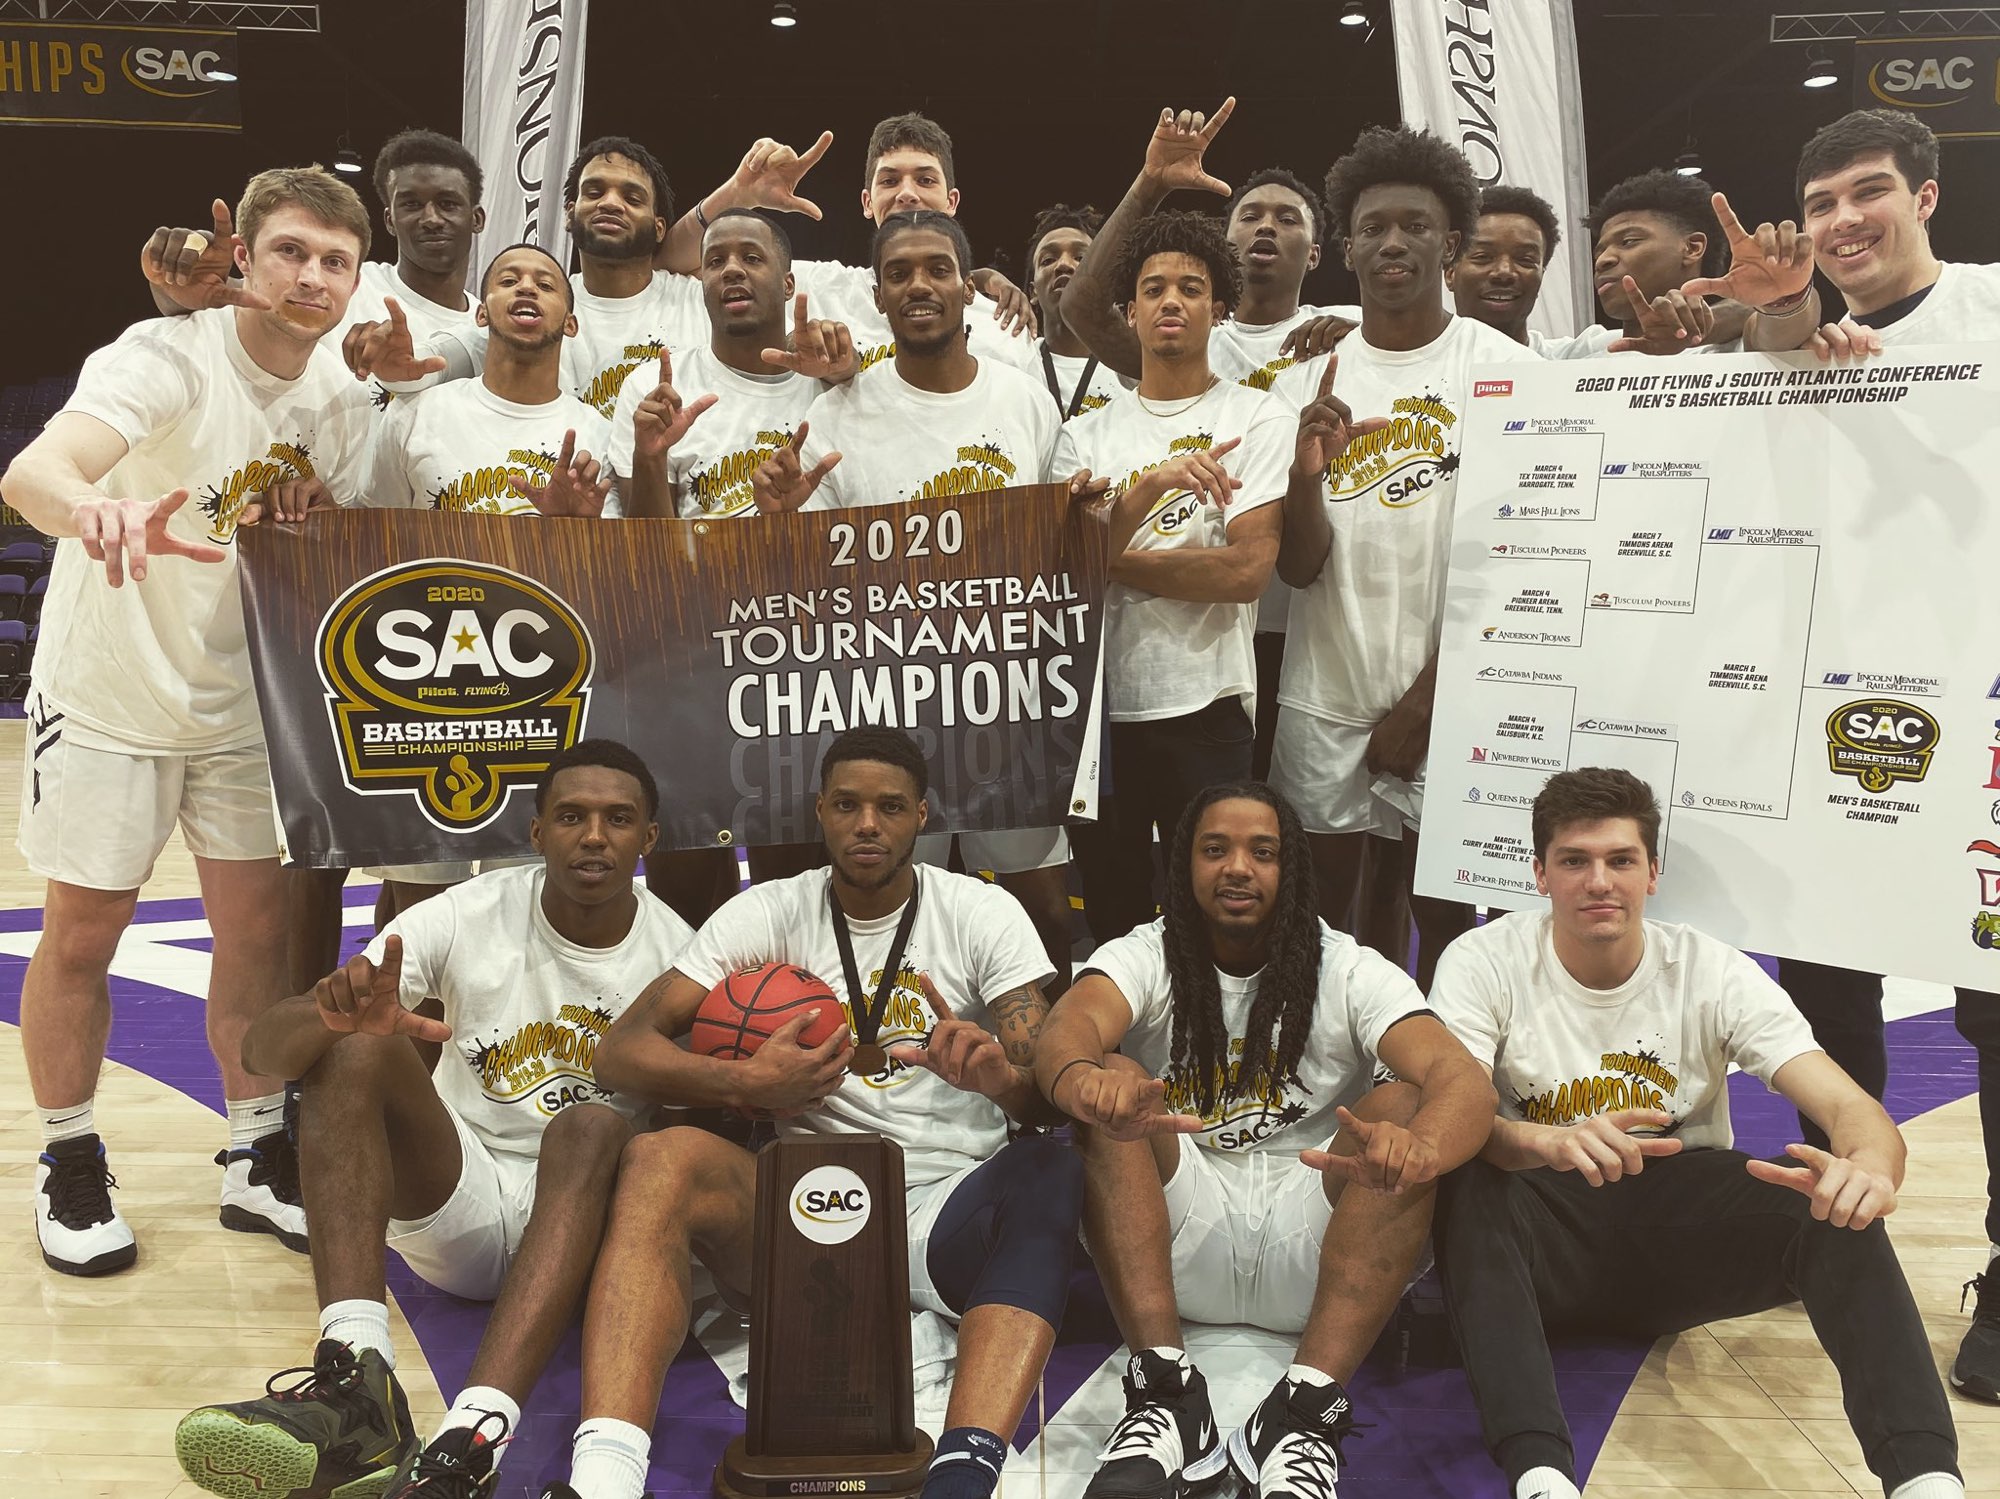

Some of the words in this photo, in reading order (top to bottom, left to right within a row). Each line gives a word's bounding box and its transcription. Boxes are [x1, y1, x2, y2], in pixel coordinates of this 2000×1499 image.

[0, 41, 105, 94] HIPS
[135, 47, 221, 82] SAC
[1883, 56, 1974, 92] SAC
[1575, 377, 1614, 392] 2020
[1618, 375, 1660, 391] PILOT
[1662, 374, 1712, 390] FLYING
[1715, 373, 1727, 388] J
[1730, 371, 1783, 388] SOUTH
[1785, 368, 1864, 386] ATLANTIC
[1866, 364, 1982, 384] CONFERENCE
[1629, 393, 1676, 409] MEN'S
[1679, 391, 1773, 408] BASKETBALL
[1777, 386, 1908, 405] CHAMPIONSHIP
[1391, 398, 1457, 430] TOURNAMENT
[1531, 419, 1559, 427] LINCOLN
[1560, 418, 1595, 427] MEMORIAL
[1329, 417, 1445, 491] CHAMPIONS
[957, 446, 1016, 479] TOURNAMENT
[1632, 461, 1662, 471] LINCOLN
[1663, 461, 1702, 471] MEMORIAL
[1386, 469, 1433, 502] SAC
[1518, 481, 1555, 489] HARROGATE,
[1520, 506, 1540, 516] MARS
[1541, 506, 1559, 516] HILL
[1560, 506, 1581, 516] LIONS
[829, 509, 963, 567] 2020
[1739, 527, 1771, 537] LINCOLN
[1771, 527, 1814, 538] MEMORIAL
[1747, 535, 1803, 544] RAILSPLITTERS
[1509, 545, 1549, 556] TUSCULUM
[1550, 546, 1587, 556] PIONEERS
[1650, 541, 1673, 549] ARENA
[1617, 549, 1657, 557] GREENVILLE,
[427, 586, 484, 602] 2020
[728, 586, 854, 624] MEN'S
[867, 572, 1079, 614] BASKETBALL
[1521, 589, 1543, 597] MARCH
[1511, 597, 1537, 605] PIONEER
[1613, 596, 1653, 607] TUSCULUM
[1654, 597, 1691, 607] PIONEERS
[1546, 606, 1563, 614] TENN.
[712, 603, 1090, 667] TOURNAMENT
[1498, 631, 1538, 641] ANDERSON
[1540, 632, 1571, 643] TROJANS
[374, 609, 555, 681] SAC
[1498, 668, 1531, 679] CATAWBA
[1532, 670, 1562, 681] INDIANS
[1723, 664, 1749, 672] MARCH
[1709, 672, 1743, 681] TIMMONS
[1744, 674, 1768, 682] ARENA
[1856, 672, 1892, 683] LINCOLN
[1893, 674, 1939, 686] MEMORIAL
[465, 686, 498, 696] FLYING
[1708, 680, 1750, 690] GREENVILLE,
[1752, 682, 1767, 690] S.C.
[1866, 681, 1928, 693] RAILSPLITTERS
[727, 654, 1080, 739] CHAMPIONS
[1508, 715, 1530, 723] MARCH
[363, 719, 558, 743] BASKETBALL
[1498, 722, 1527, 731] GOODMAN
[1528, 724, 1544, 733] GYM
[1598, 721, 1634, 733] CATAWBA
[1635, 724, 1667, 735] INDIANS
[1846, 713, 1924, 743] SAC
[1496, 730, 1530, 740] SALISBURY,
[1532, 732, 1544, 740] N.C.
[397, 740, 525, 755] CHAMPIONSHIP
[1491, 751, 1529, 763] NEWBERRY
[1531, 756, 1561, 767] WOLVES
[1838, 751, 1920, 766] BASKETBALL
[1487, 792, 1518, 802] QUEENS
[1702, 796, 1738, 810] QUEENS
[1740, 800, 1773, 812] ROYALS
[1827, 794, 1859, 806] MEN'S
[1860, 798, 1920, 813] BASKETBALL
[1846, 810, 1899, 824] CHAMPION
[1462, 839, 1483, 847] CURRY
[1483, 842, 1503, 851] ARENA
[1507, 846, 1528, 855] LEVINE
[1494, 836, 1516, 845] MARCH
[1600, 1053, 1678, 1097] TOURNAMENT
[543, 1085, 591, 1111] SAC
[1218, 1121, 1272, 1149] SAC
[806, 1189, 865, 1213] SAC
[790, 1480, 866, 1494] CHAMPIONS
